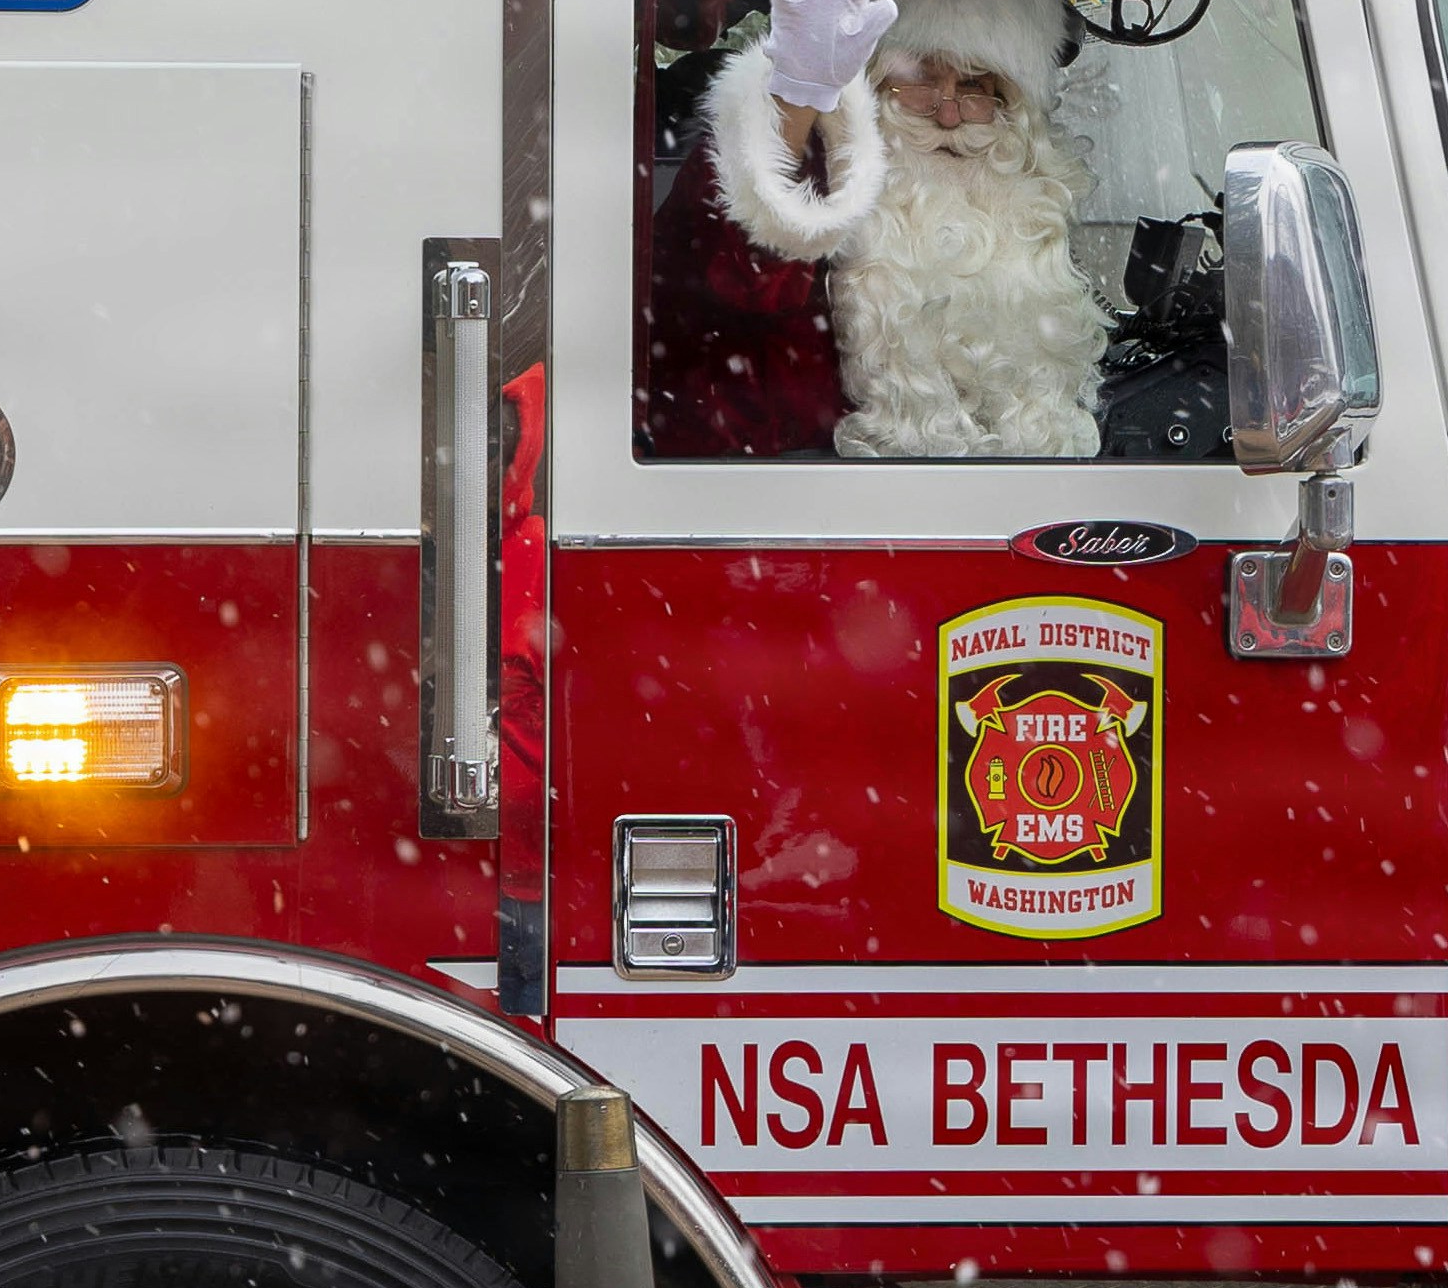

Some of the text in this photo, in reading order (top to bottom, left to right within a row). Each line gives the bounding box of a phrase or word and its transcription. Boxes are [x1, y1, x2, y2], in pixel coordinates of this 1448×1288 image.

[1059, 526, 1150, 557] Saber
[951, 622, 1151, 662] NAVAL DISTRICT
[1015, 714, 1087, 742] FIRE
[1016, 814, 1084, 843] EMS
[968, 878, 1136, 915] WASHINGTON
[700, 1039, 1421, 1150] NSA BETHESDA
